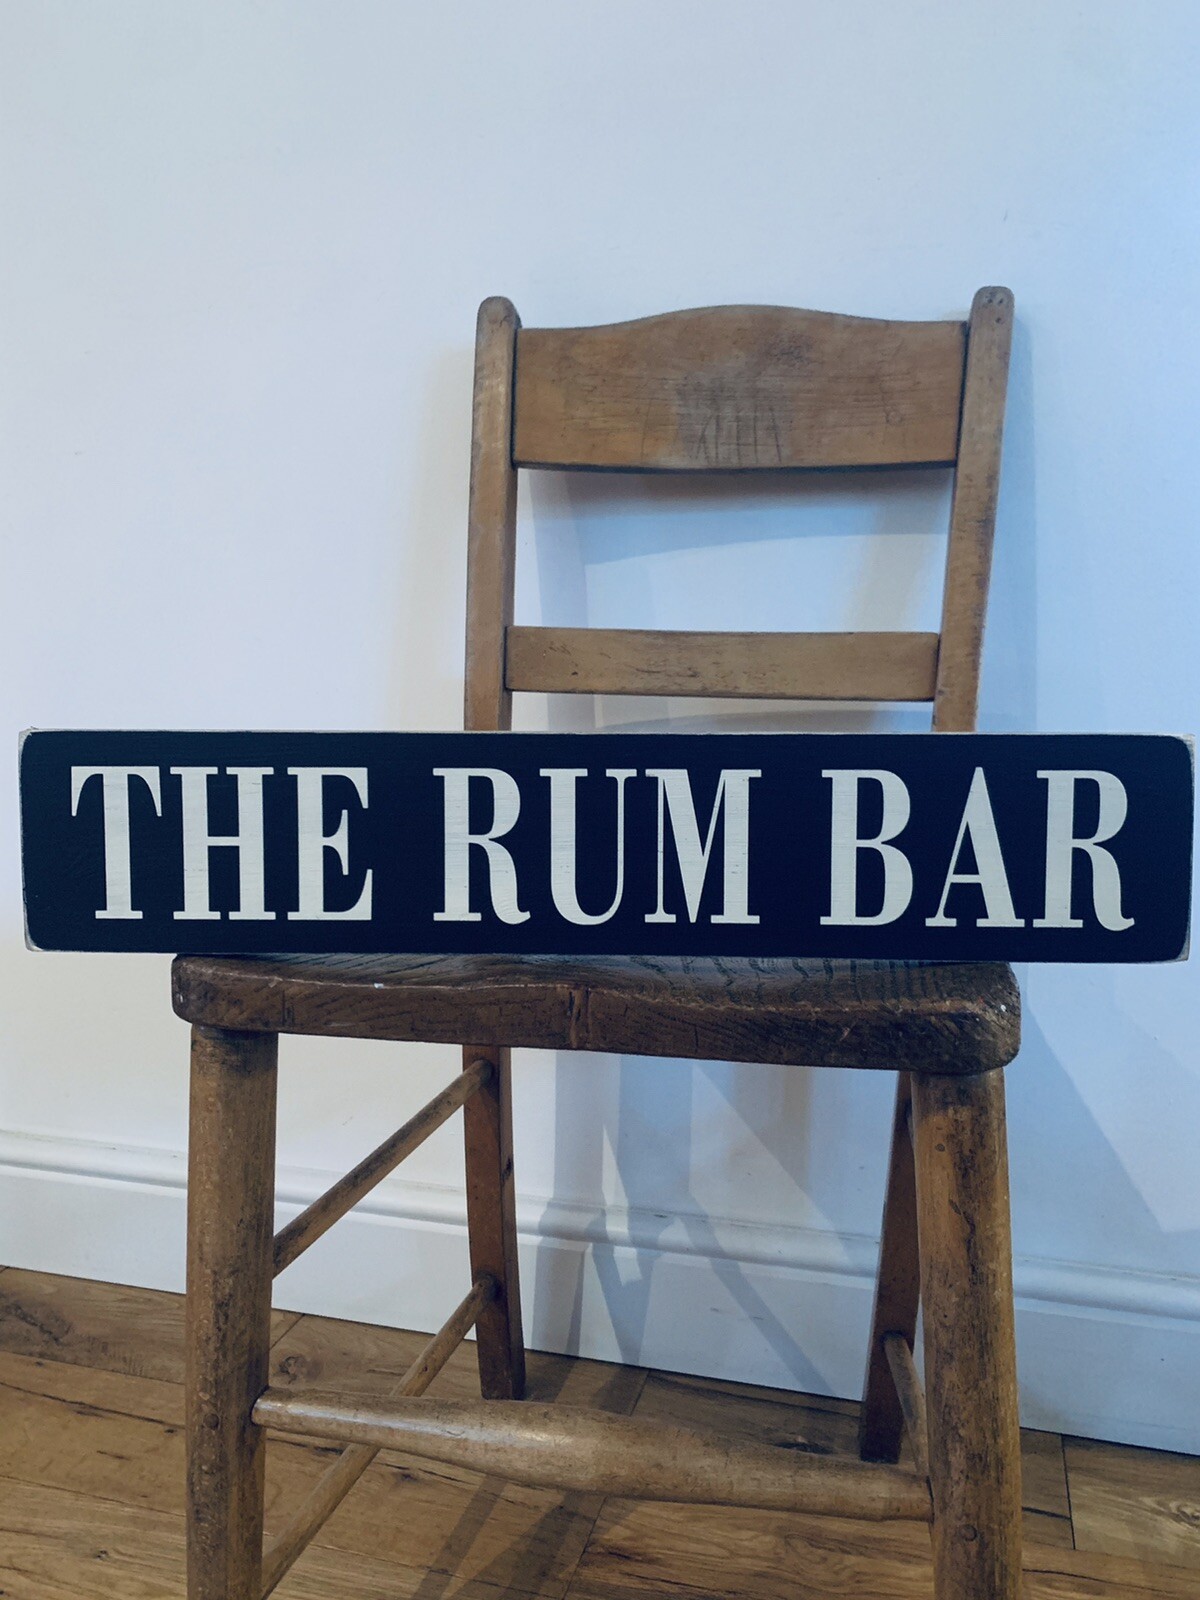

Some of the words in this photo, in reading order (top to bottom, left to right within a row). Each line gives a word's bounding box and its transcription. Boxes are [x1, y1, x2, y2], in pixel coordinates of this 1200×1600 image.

[70, 765, 373, 921] THE
[432, 767, 762, 926] RUM
[819, 766, 1135, 931] BAR
